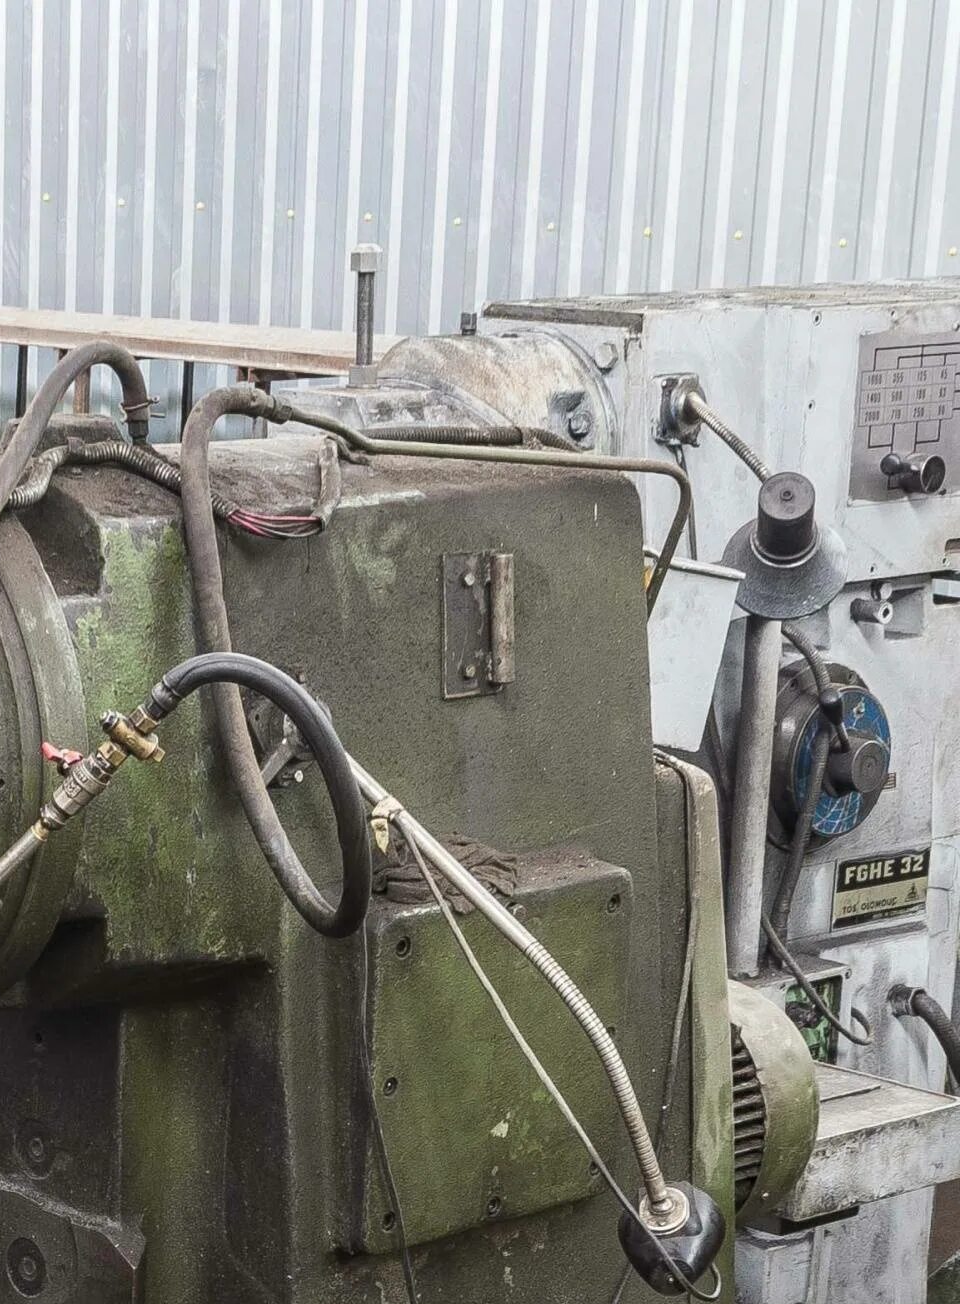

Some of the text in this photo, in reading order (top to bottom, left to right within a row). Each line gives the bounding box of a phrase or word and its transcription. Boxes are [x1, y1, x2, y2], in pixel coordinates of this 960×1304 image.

[844, 855, 924, 885] FGHE 32
[842, 902, 857, 914] TOS
